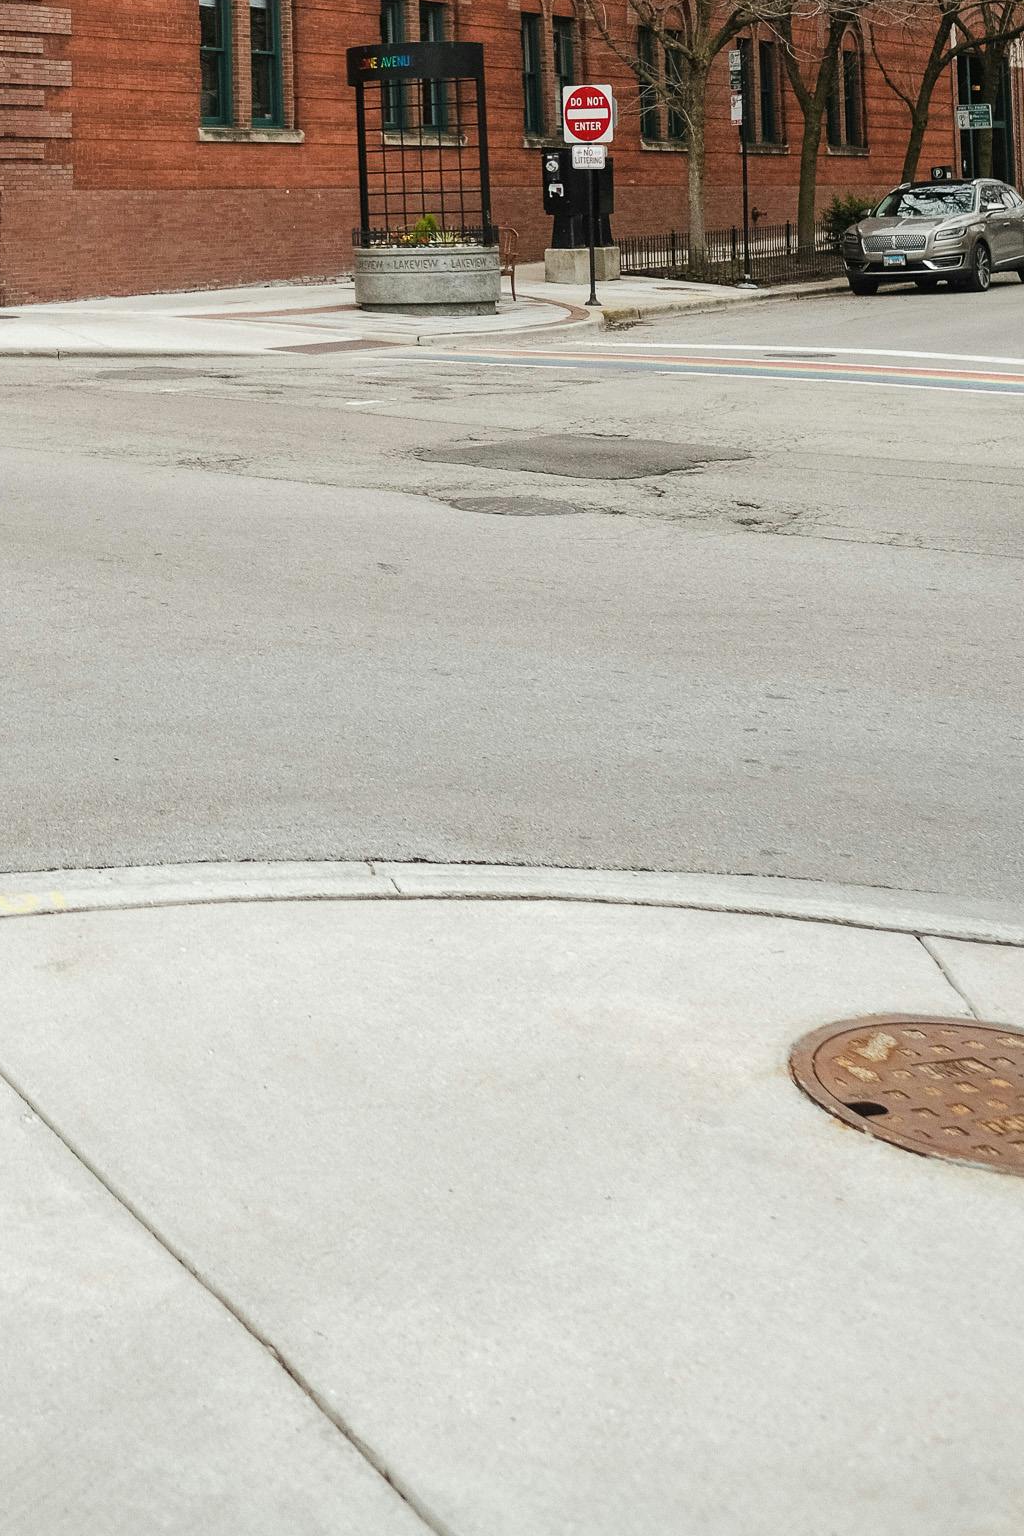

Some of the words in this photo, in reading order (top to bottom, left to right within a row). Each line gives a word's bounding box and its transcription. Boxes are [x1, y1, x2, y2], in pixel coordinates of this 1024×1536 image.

[570, 97, 582, 107] DO
[587, 96, 604, 106] NOT
[574, 121, 602, 131] ENTER
[574, 156, 602, 164] LITTERING
[393, 259, 439, 270] LAKEVIEW
[451, 257, 488, 269] LAKEVIEW
